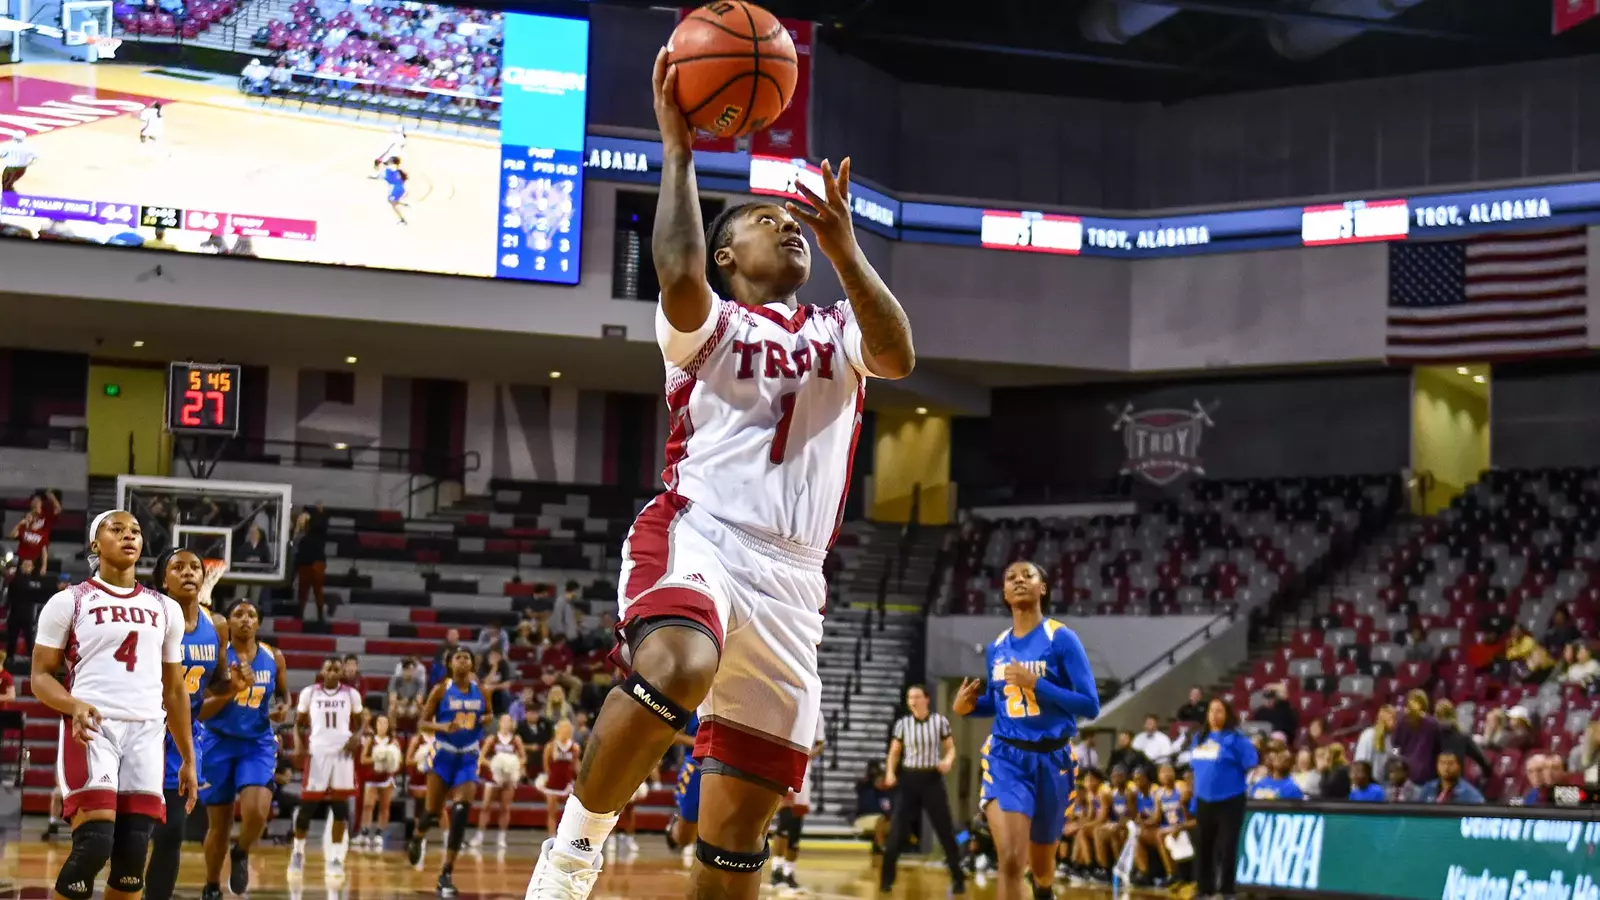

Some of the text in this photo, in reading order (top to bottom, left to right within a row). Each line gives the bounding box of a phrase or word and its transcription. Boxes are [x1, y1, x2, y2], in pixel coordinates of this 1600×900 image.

[584, 149, 648, 171] ABAMA
[100, 204, 133, 222] 44
[1468, 197, 1551, 223] ALABAMA
[1136, 225, 1210, 249] ALABAMA
[732, 338, 836, 380] TROY
[182, 391, 224, 426] 27
[769, 392, 796, 465] 1
[89, 606, 159, 628] TROY
[113, 631, 138, 672] 4
[640, 688, 676, 721] Mueller
[1003, 684, 1041, 718] 21
[325, 711, 337, 729] 11
[1235, 811, 1325, 889] SARHA
[1442, 864, 1509, 900] Newton
[1509, 869, 1572, 900] Family
